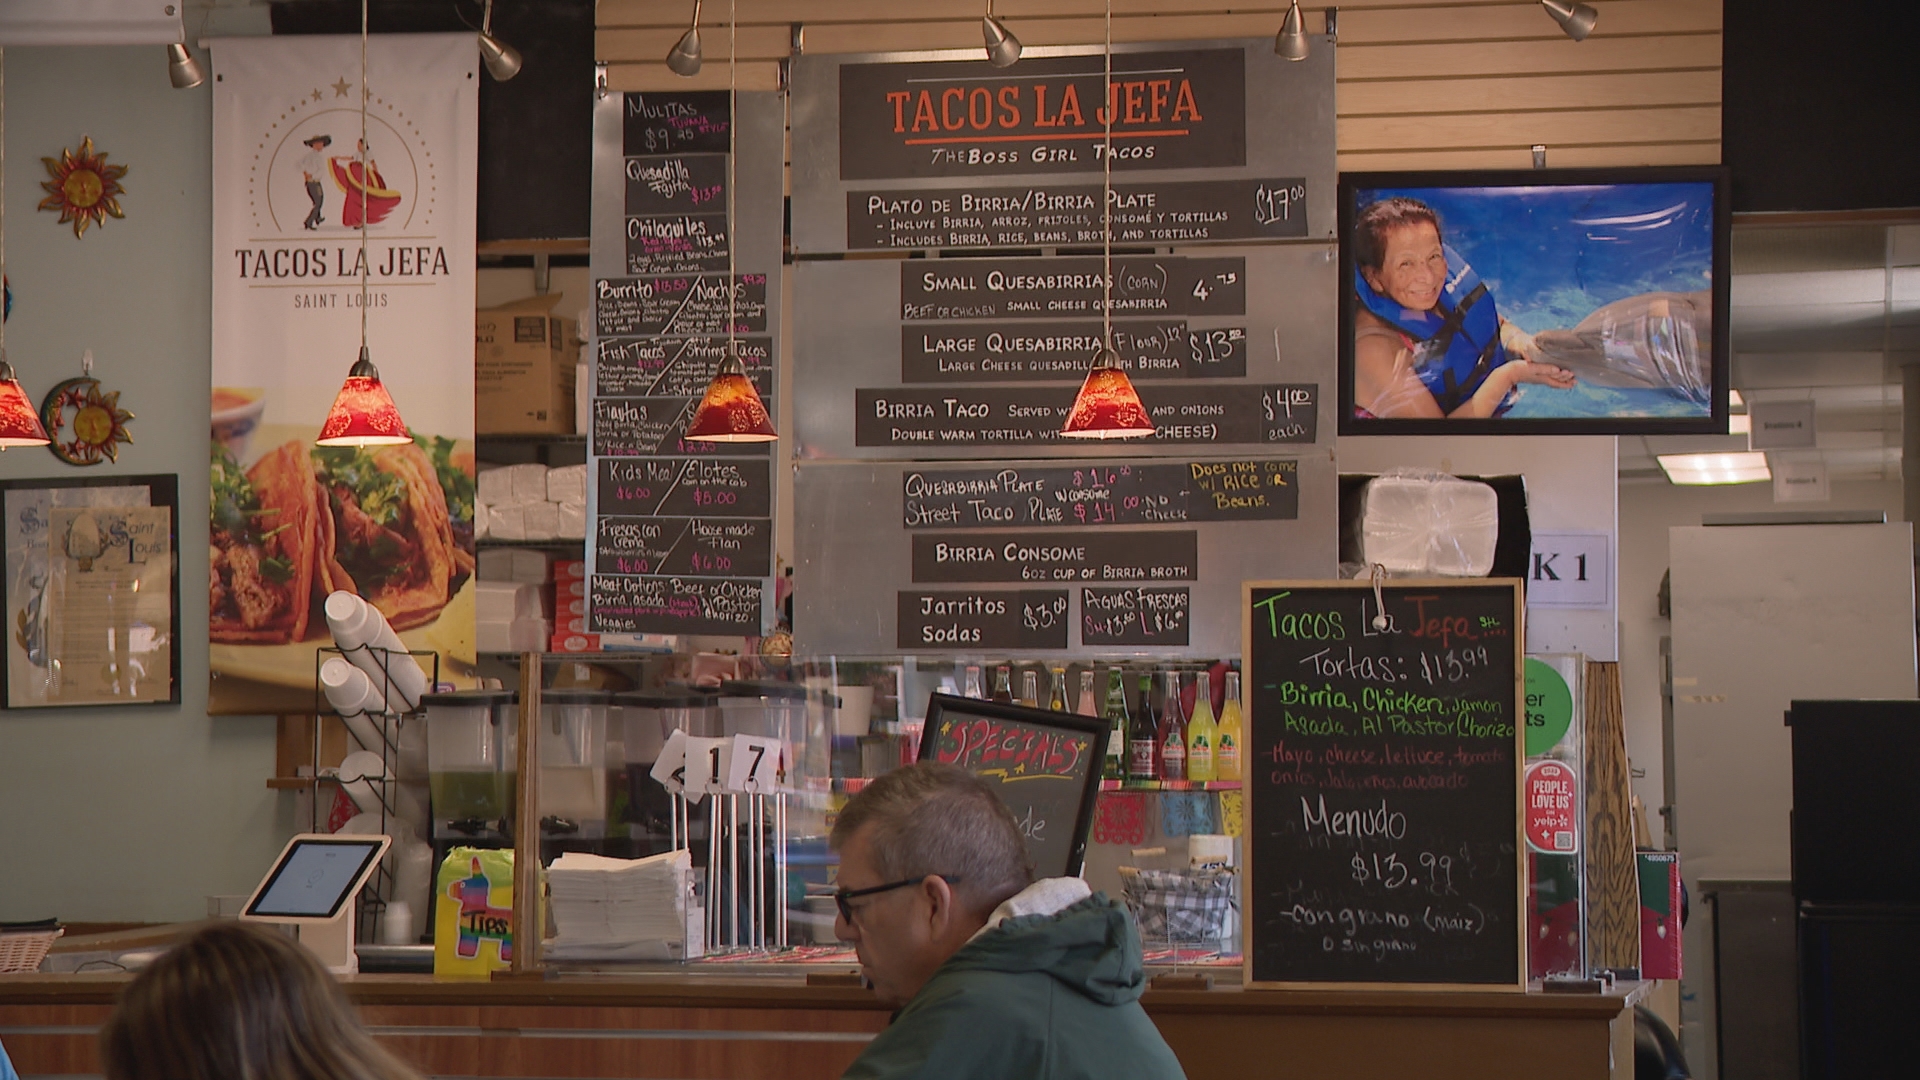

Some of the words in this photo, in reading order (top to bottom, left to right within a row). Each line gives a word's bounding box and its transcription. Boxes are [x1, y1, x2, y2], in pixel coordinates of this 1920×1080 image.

[886, 86, 1021, 133] TACOS
[1033, 83, 1086, 127] LA
[1096, 79, 1203, 126] JEFA
[1031, 146, 1078, 162] GIRL
[626, 159, 690, 182] Quesadilla
[868, 195, 923, 215] PLATO
[932, 199, 951, 213] DE
[890, 218, 936, 230] INCLUYE
[1170, 211, 1229, 223] TORTILLAS
[890, 234, 944, 247] INCLUDES
[1122, 229, 1144, 240] AND
[1150, 228, 1209, 239] TORTILLAS
[235, 248, 327, 278] TACOS
[337, 247, 371, 277] LA
[379, 246, 450, 276] JEFA
[597, 279, 653, 299] Burrito
[923, 272, 977, 292] SMALL
[986, 270, 1114, 291] QUESABIRRIAS
[294, 294, 338, 308] SAINT
[346, 293, 388, 308] LOUIS
[1007, 300, 1041, 311] SMALL
[1047, 300, 1087, 311] CHEESE
[923, 334, 977, 353] LARGE
[986, 332, 1102, 354] QUESABIRRIA
[939, 358, 976, 372] LARGE
[981, 358, 1023, 371] CHEESE
[1138, 355, 1180, 369] BIRRIA
[875, 399, 935, 418] BIRRIA
[943, 398, 990, 418] TACO
[1008, 404, 1051, 417] SERVED
[1152, 405, 1176, 416] AND
[1180, 404, 1225, 415] ONIONS
[891, 427, 935, 441] DOUBLE
[940, 427, 976, 440] WARM
[980, 428, 1034, 440] TORTILLA
[1038, 428, 1062, 440] WIT
[609, 461, 642, 482] Kids
[686, 459, 740, 479] Elotes
[905, 500, 961, 526] Street
[967, 499, 1014, 522] Taco
[935, 542, 995, 562] BIRRIA
[1003, 542, 1086, 562] CONSOME
[1053, 568, 1076, 580] CUP
[1081, 567, 1097, 579] OF
[1102, 564, 1145, 579] BIRRIA
[1151, 565, 1189, 578] BROTH
[1574, 552, 1590, 581] 1
[920, 596, 1007, 616] Jarritos
[1253, 591, 1346, 641] Tacos
[1404, 595, 1478, 648] Jefa
[922, 622, 981, 643] Sodas
[1388, 714, 1454, 736] Pastor
[938, 719, 1080, 775] SPECIALS
[709, 747, 720, 784] 1
[748, 745, 766, 783] 7
[1532, 780, 1568, 795] PEOPLE
[1531, 794, 1555, 809] LOVE
[1556, 794, 1569, 809] US
[1300, 793, 1407, 840] Menudo
[1534, 815, 1557, 829] yelp
